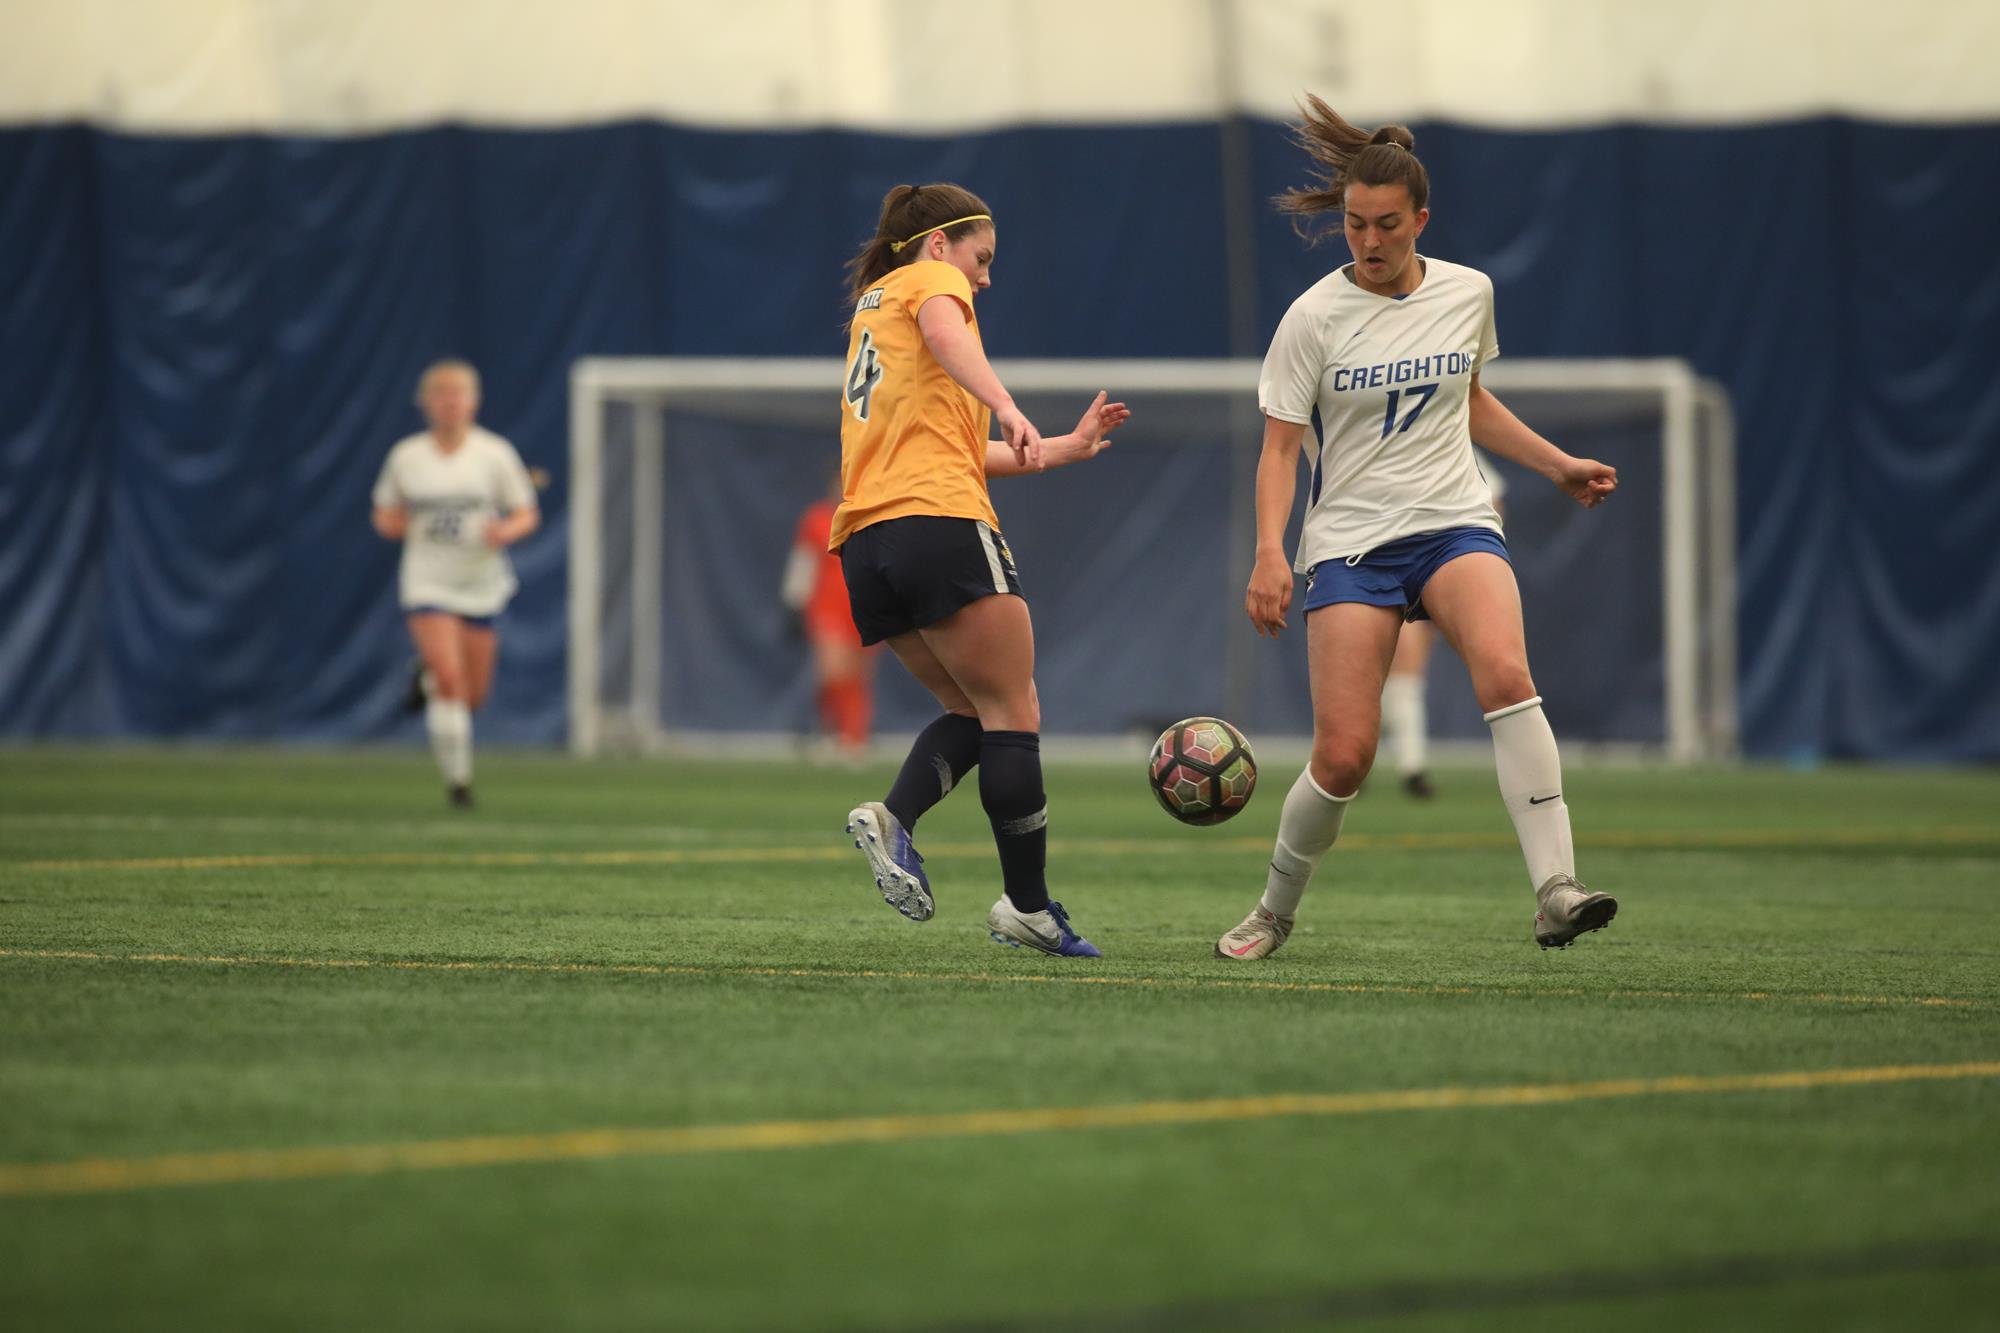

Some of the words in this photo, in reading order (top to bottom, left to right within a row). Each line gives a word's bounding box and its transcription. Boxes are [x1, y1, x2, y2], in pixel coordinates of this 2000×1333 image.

[845, 327, 883, 423] 4
[1334, 352, 1471, 392] CREIGHTON
[1381, 383, 1440, 440] 17
